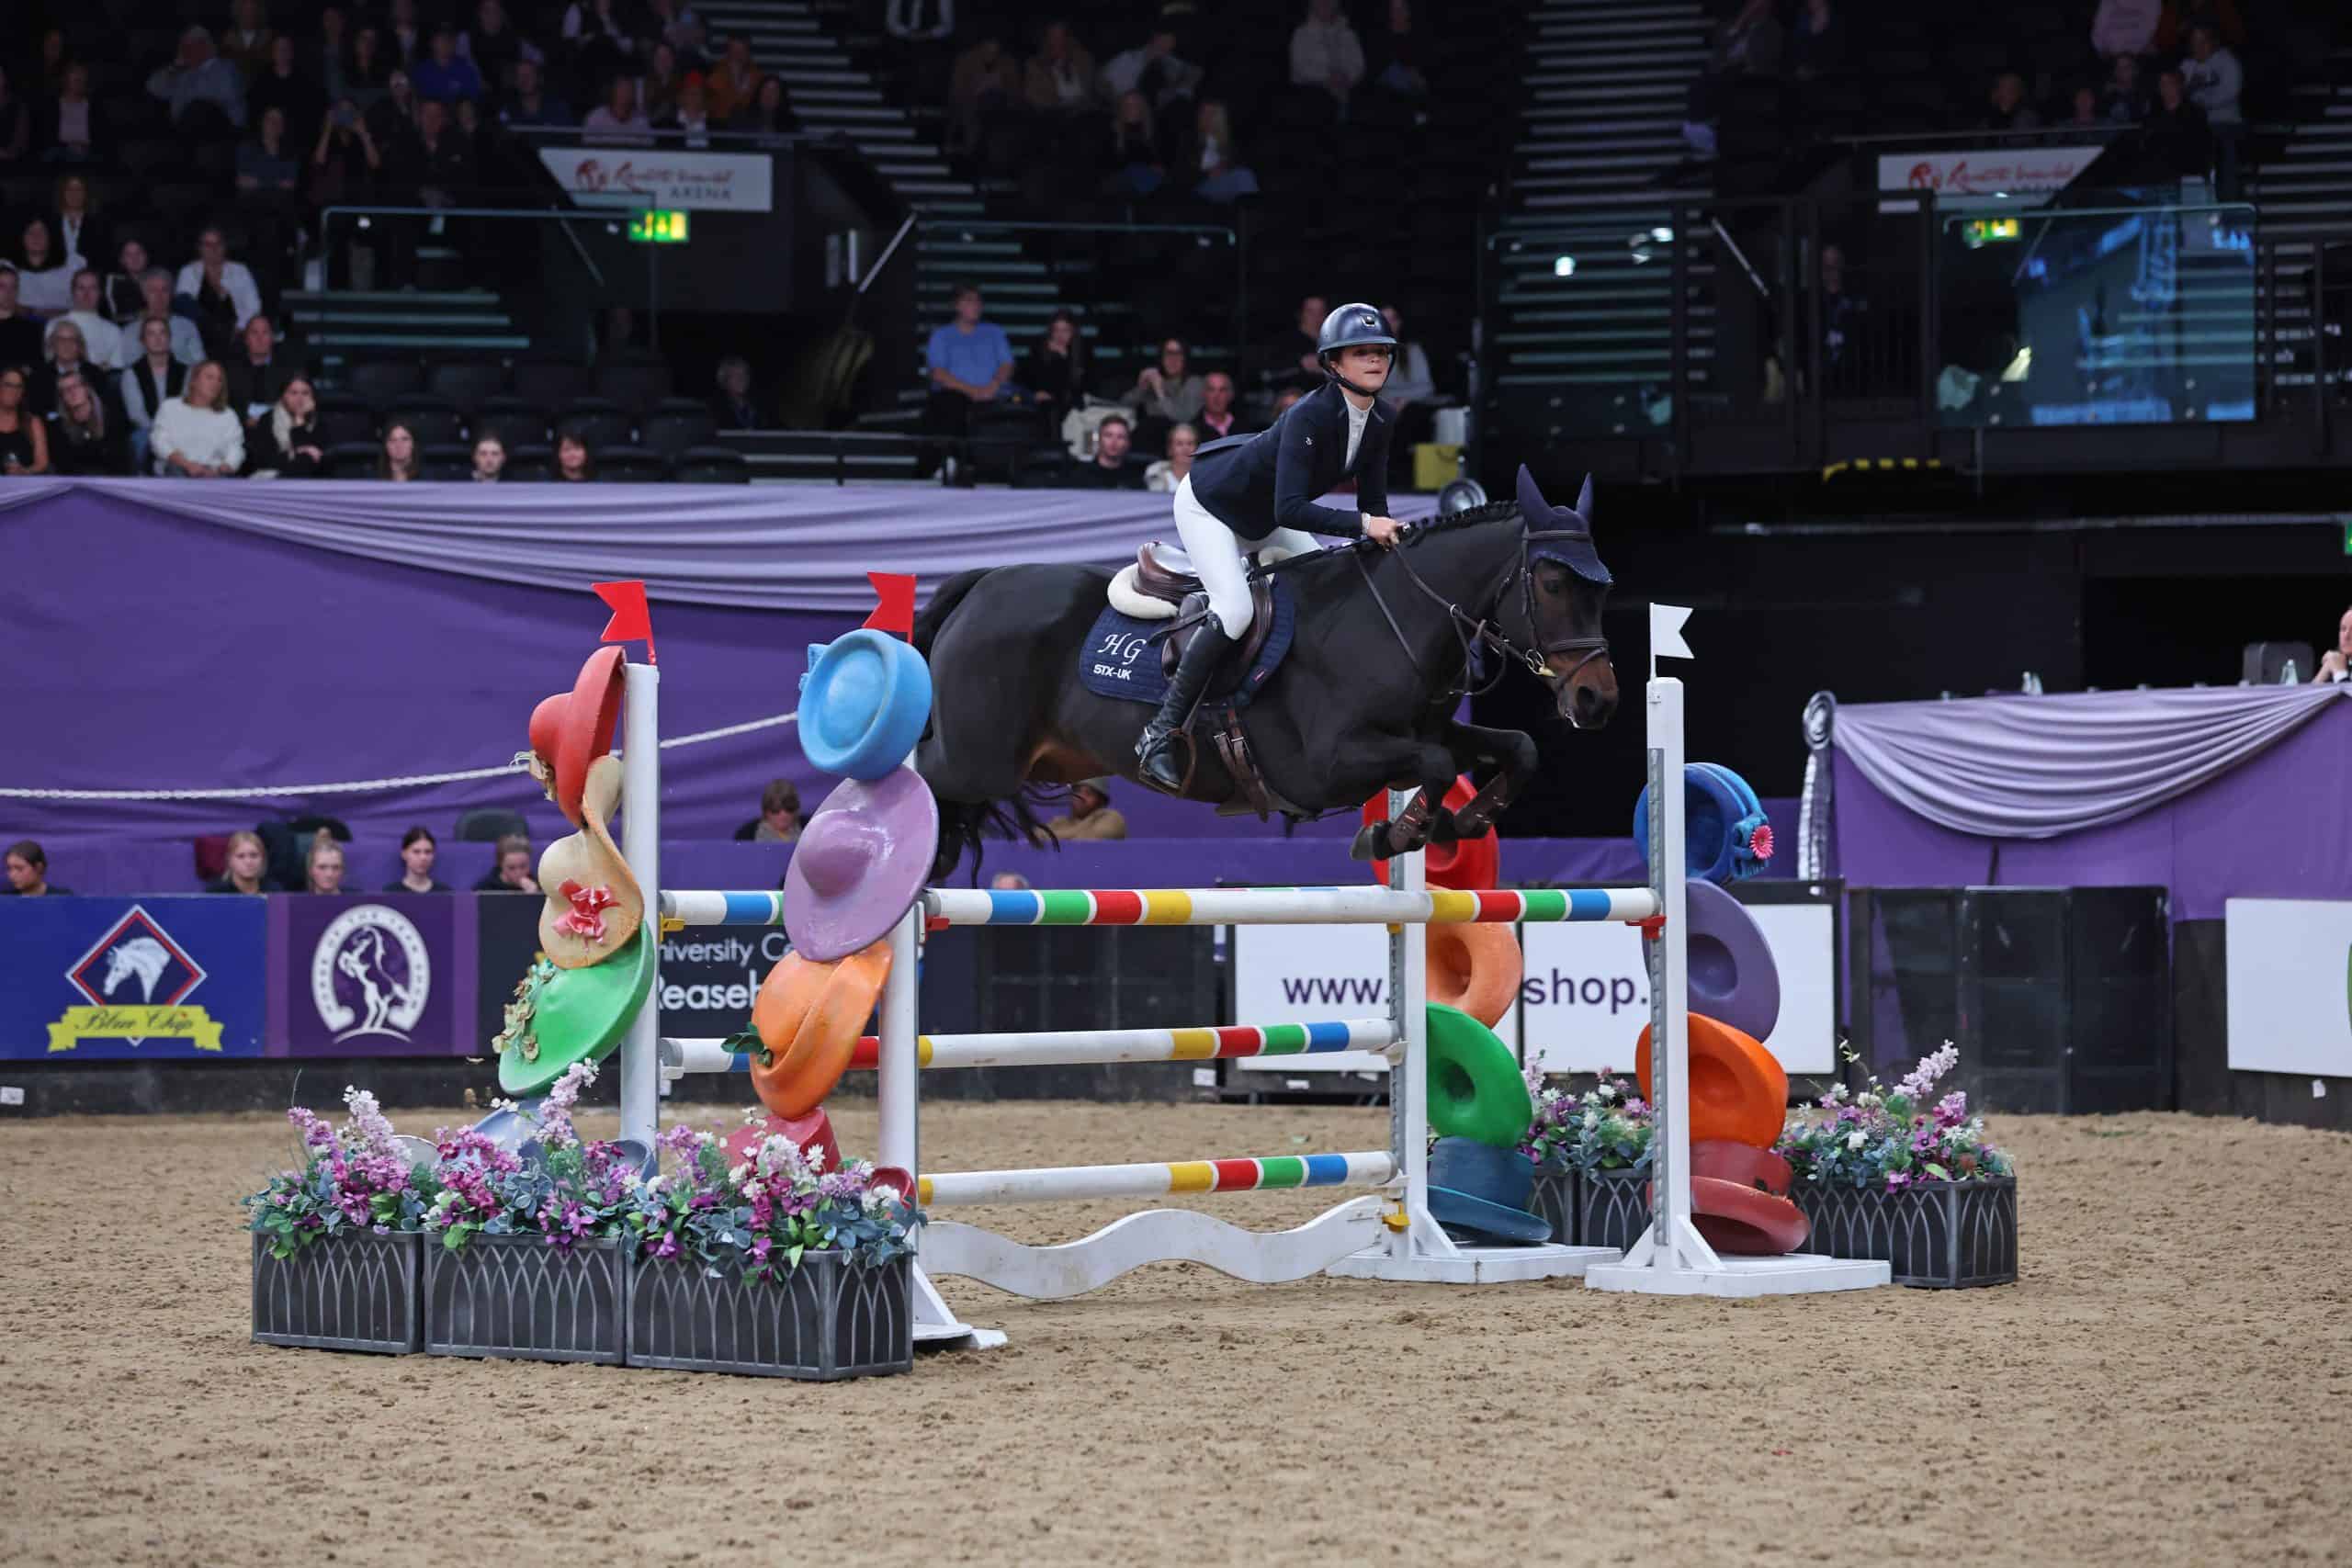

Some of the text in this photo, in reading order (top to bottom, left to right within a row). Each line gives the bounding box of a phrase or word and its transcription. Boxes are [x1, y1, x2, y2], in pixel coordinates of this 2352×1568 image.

[1093, 664, 1132, 680] STX-UK
[659, 968, 762, 1009] easeh
[1523, 967, 1648, 1014] shop.
[74, 1008, 195, 1035] Blue Chip
